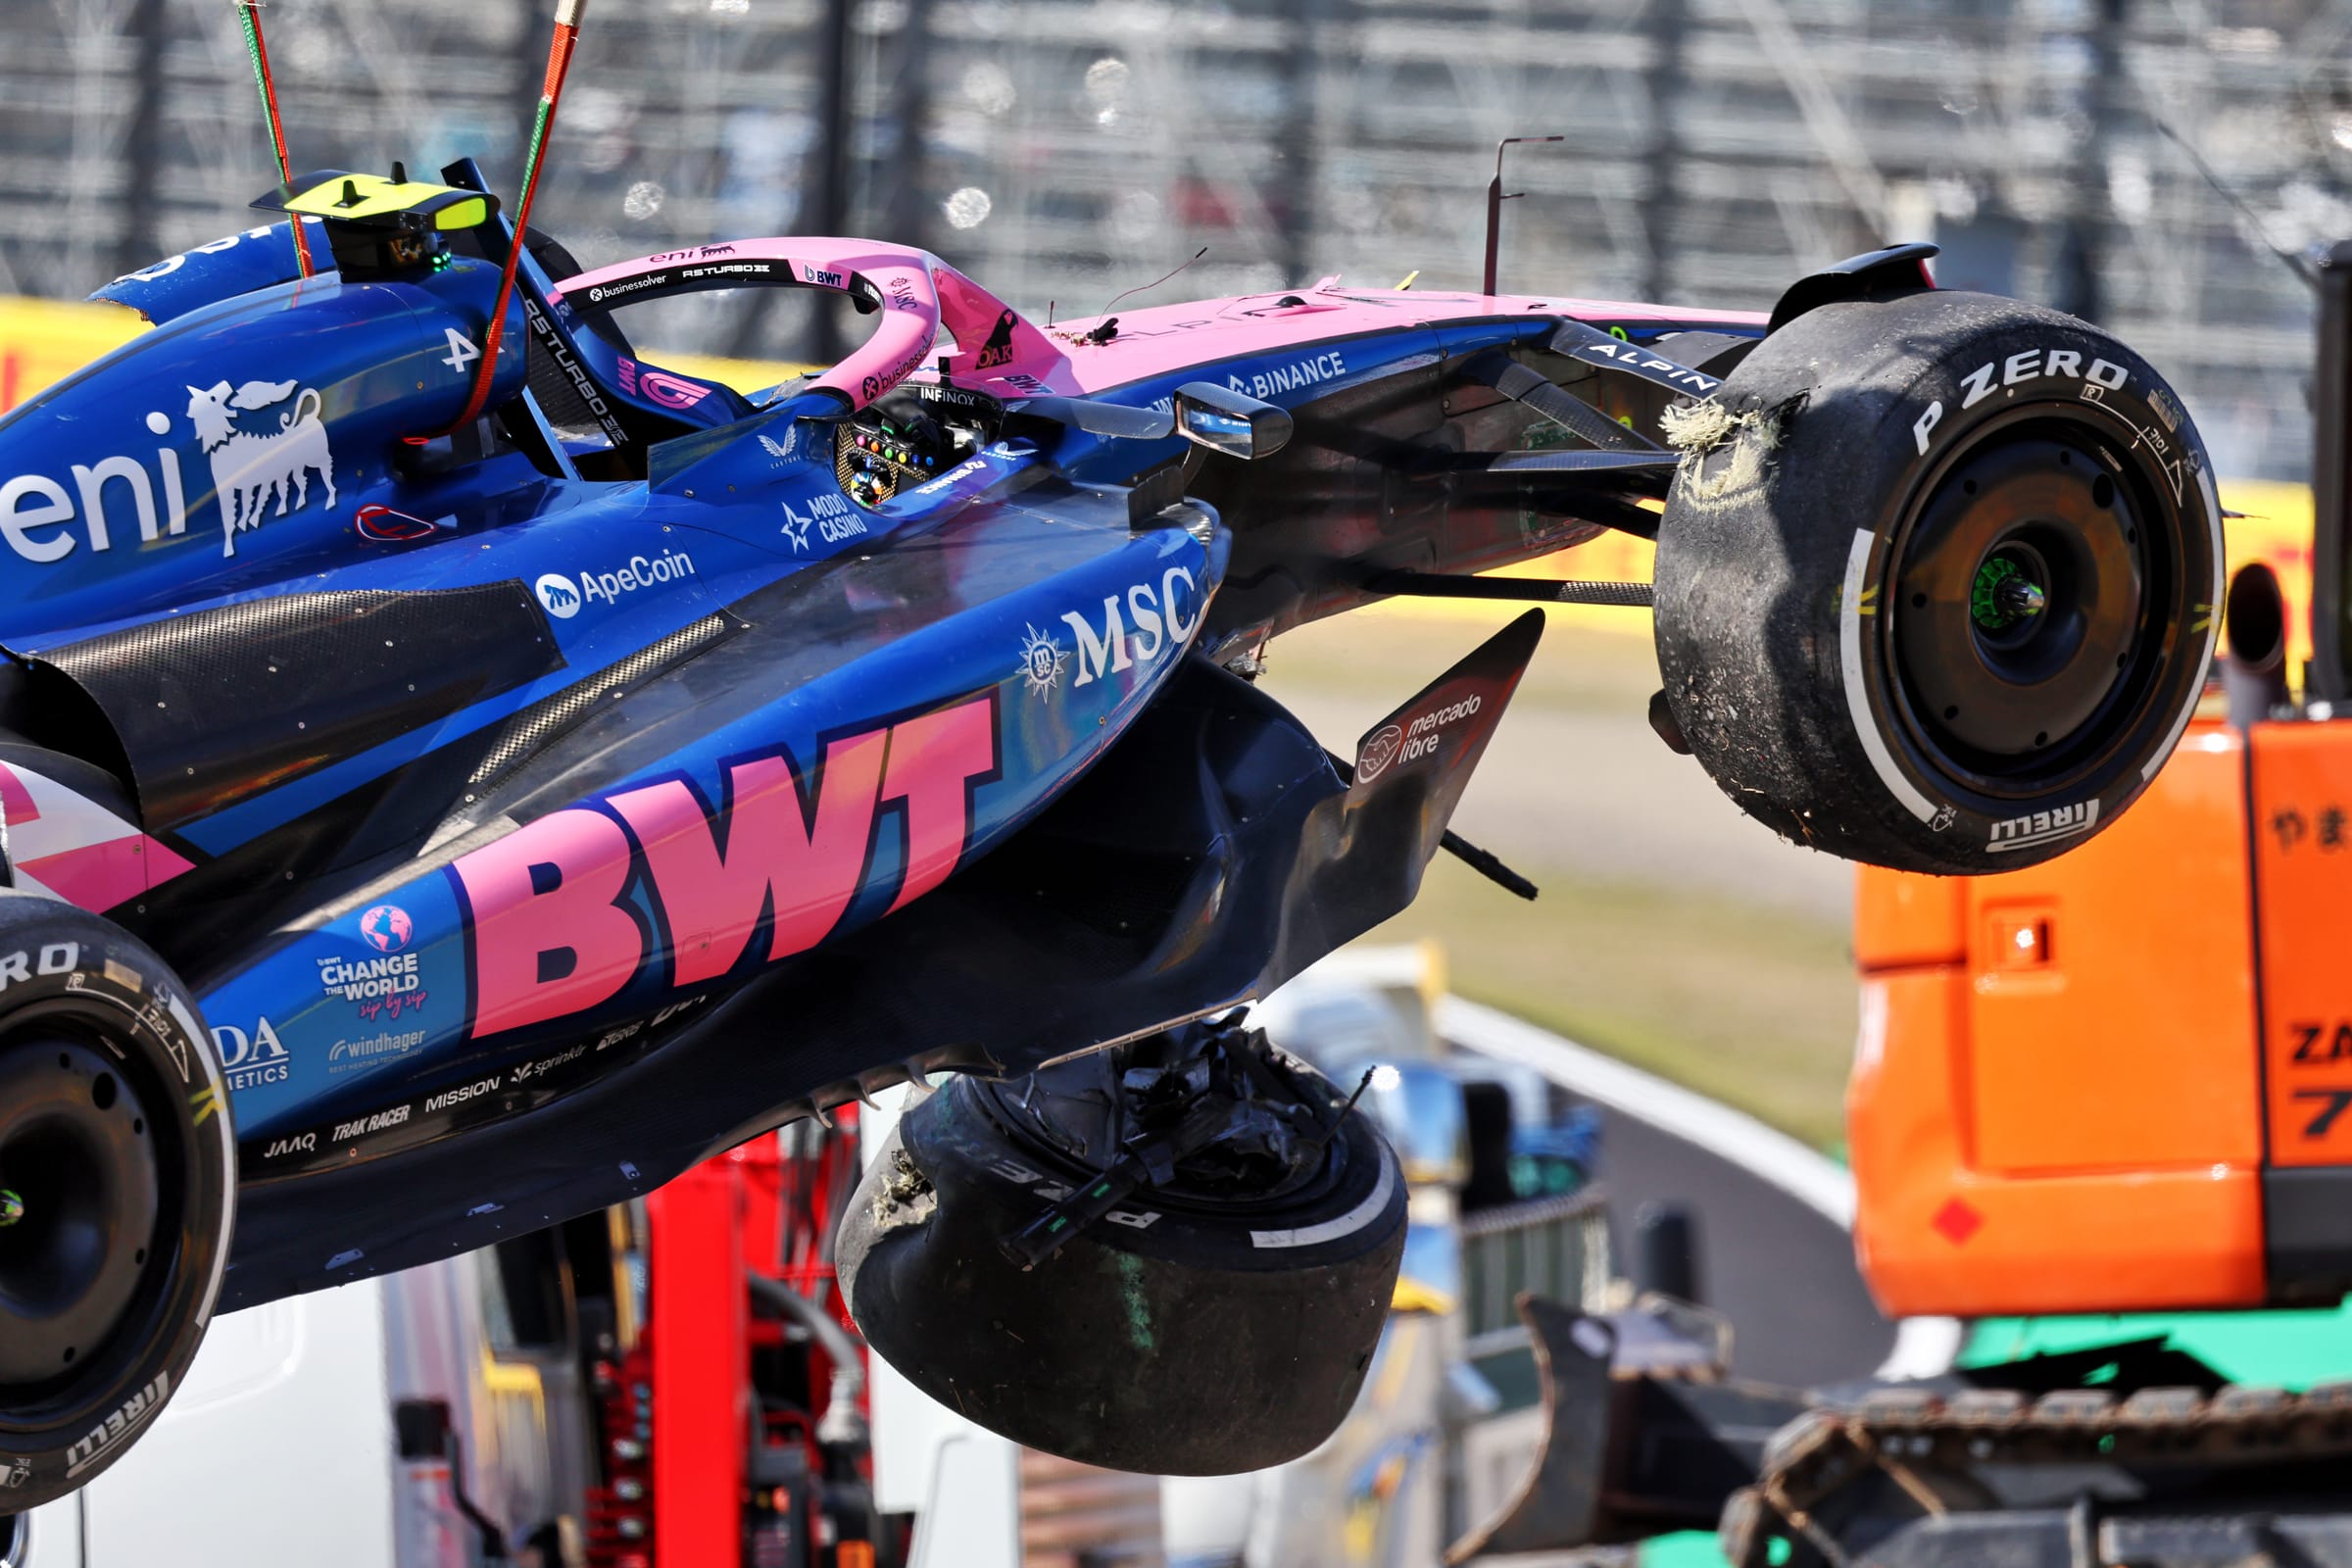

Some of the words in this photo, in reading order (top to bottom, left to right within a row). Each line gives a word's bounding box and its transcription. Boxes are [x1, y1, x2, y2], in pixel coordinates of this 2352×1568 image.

[649, 246, 694, 263] eni
[603, 274, 667, 298] businessolver
[817, 270, 842, 286] BWT
[617, 356, 637, 397] BWT
[1252, 351, 1347, 400] BINANCE
[1589, 344, 1718, 391] ALPIN
[920, 387, 974, 406] INFINOX
[1913, 401, 1943, 457] P
[1960, 349, 2129, 410] ZERO
[0, 412, 186, 564] eni
[807, 493, 849, 520] MODO
[818, 513, 868, 543] CASINO
[580, 549, 696, 605] ApeCoin
[1060, 565, 1196, 688] MSC
[1406, 694, 1482, 738] mercado
[1397, 733, 1440, 764] libre
[1984, 798, 2099, 854] PIRELLI
[453, 698, 994, 1039] BWT
[320, 953, 418, 985] CHANGE
[323, 985, 344, 996] THE
[344, 973, 419, 1001] WORLD
[360, 1000, 382, 1020] sip
[385, 987, 403, 1018] by
[405, 990, 427, 1010] sip
[348, 1029, 426, 1058] windhager
[425, 1076, 501, 1112] MISSION
[331, 1119, 367, 1143] TRAK
[367, 1104, 411, 1133] RACER
[264, 1132, 317, 1158] JAAQ
